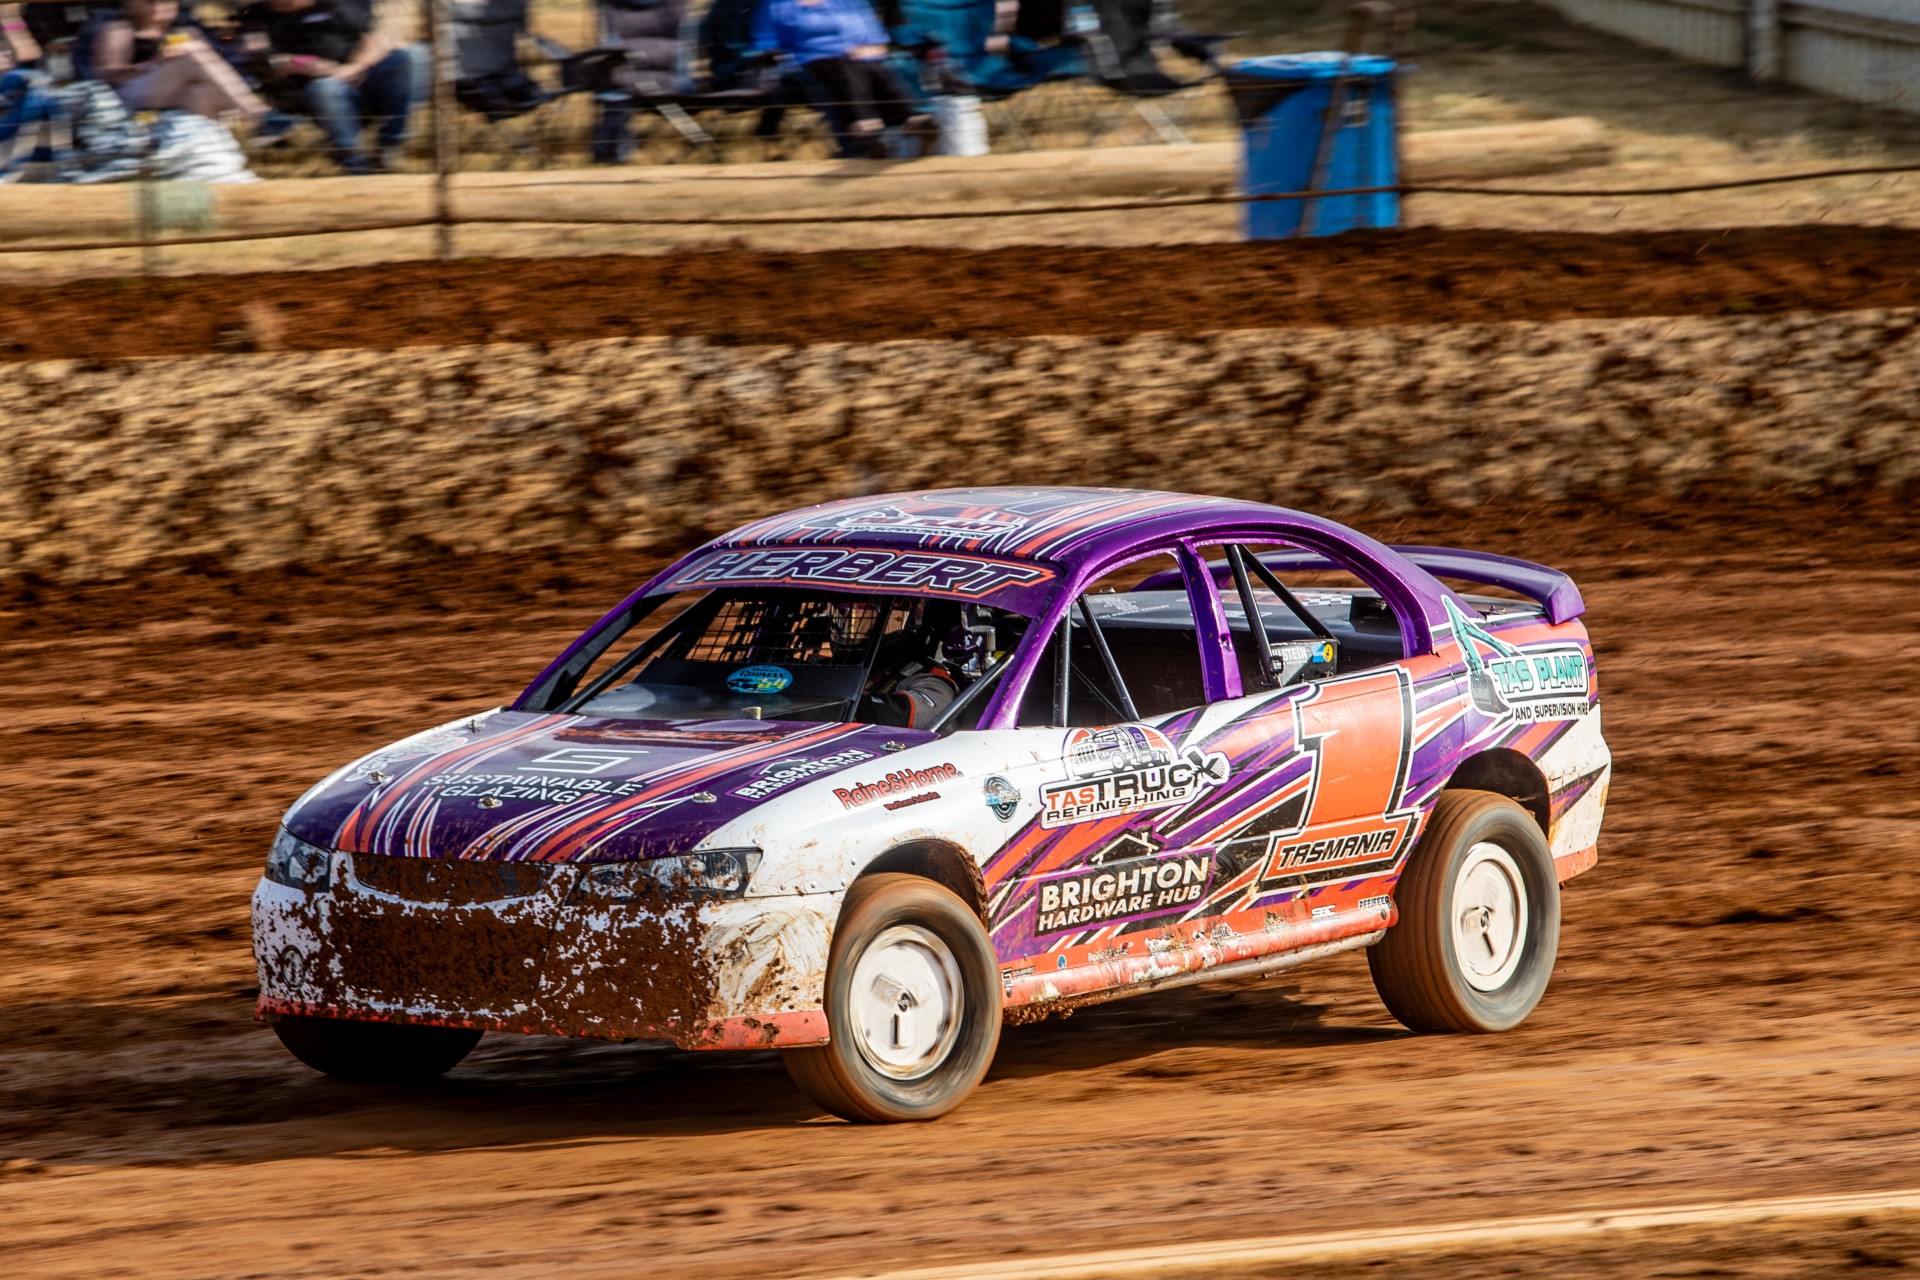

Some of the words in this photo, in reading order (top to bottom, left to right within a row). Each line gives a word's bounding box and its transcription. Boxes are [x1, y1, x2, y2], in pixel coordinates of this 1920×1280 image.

[675, 550, 1043, 593] HERBERT
[1491, 659, 1534, 694] TAS
[1532, 654, 1584, 690] PLANT
[1515, 706, 1532, 721] AND
[1534, 702, 1576, 718] SUPERVISION
[1577, 702, 1589, 716] HIRE
[423, 774, 643, 796] SUSTAINABLE
[440, 785, 582, 803] GLAZING
[734, 749, 867, 797] BRIGHTON
[750, 762, 838, 799] HARDWARE
[839, 752, 875, 766] HUB
[1260, 666, 1422, 888] 1
[1046, 787, 1186, 821] REFINISHING
[1277, 827, 1399, 870] TASMANIA
[1041, 856, 1209, 913] BRIGHTON
[1038, 893, 1152, 932] HARDWARE
[1157, 884, 1202, 906] HUB
